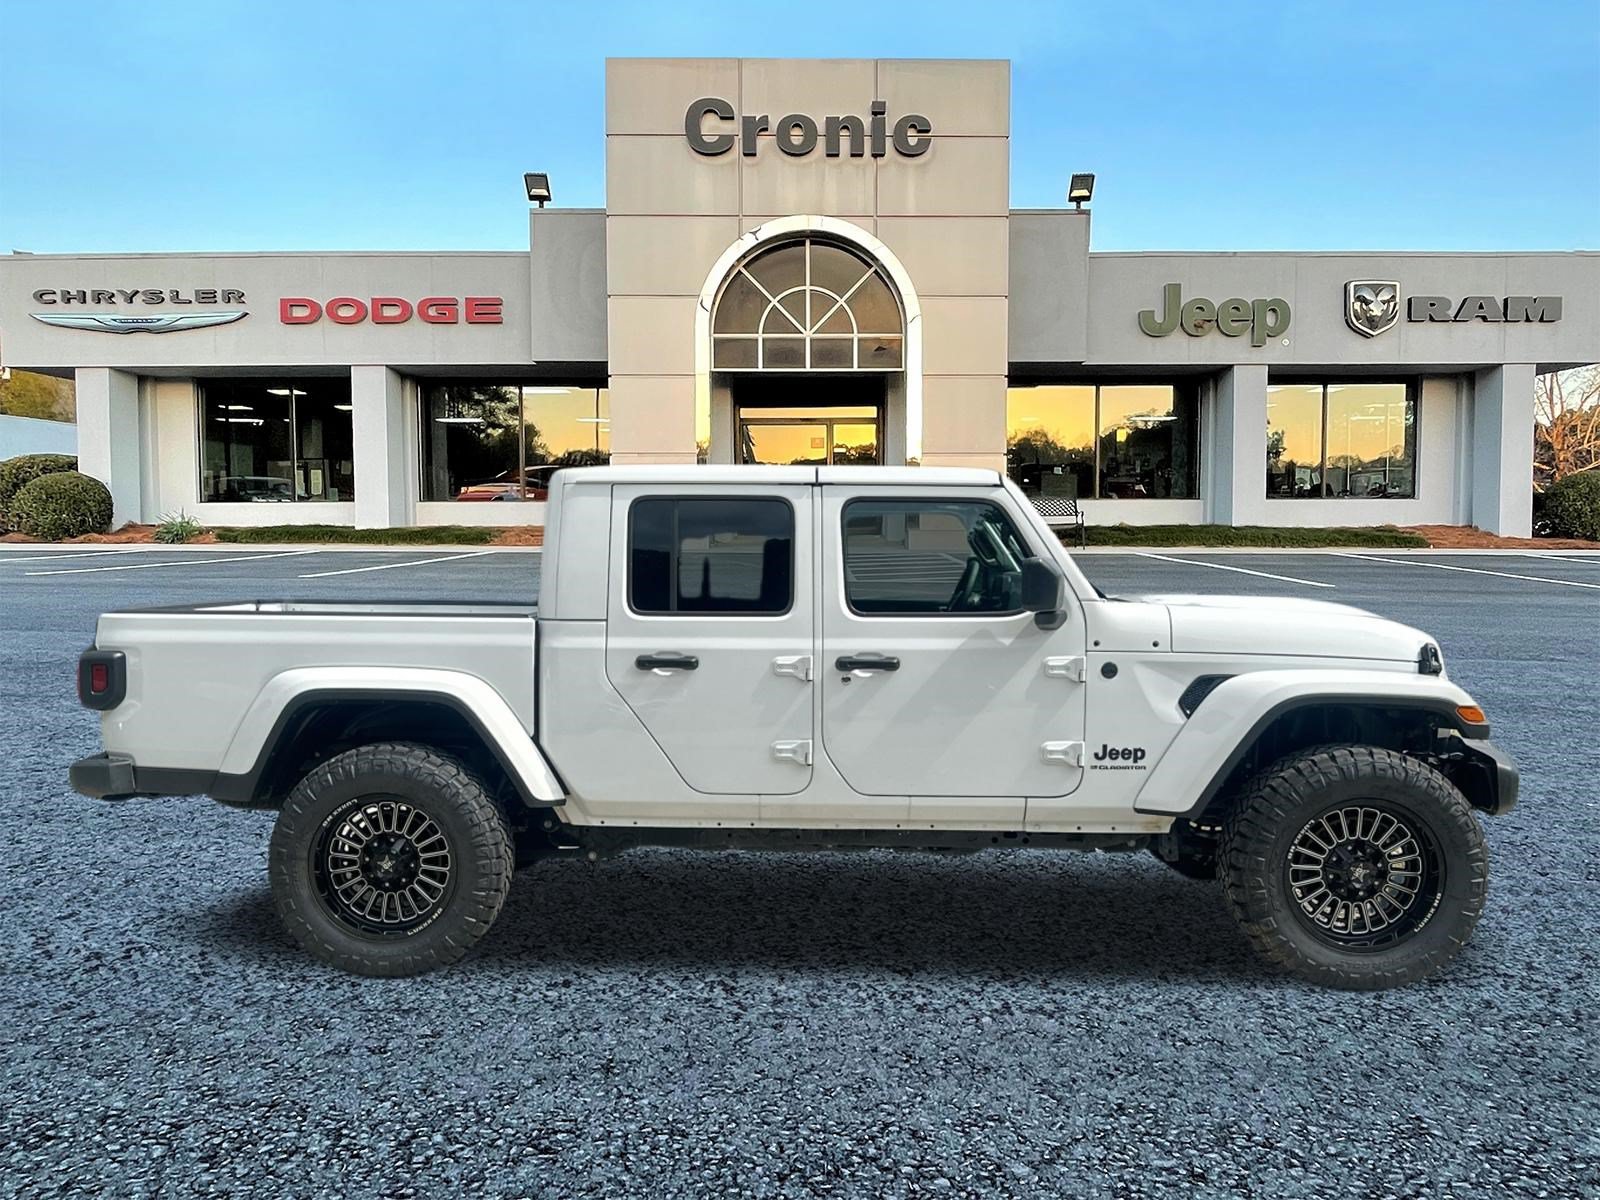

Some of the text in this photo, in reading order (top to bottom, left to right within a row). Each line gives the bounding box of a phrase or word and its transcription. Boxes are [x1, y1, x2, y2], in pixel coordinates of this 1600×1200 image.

[685, 97, 932, 157] Cronic
[32, 288, 247, 305] CHRYSLER
[1407, 295, 1563, 323] RAM
[279, 297, 503, 325] DODGE
[1138, 283, 1292, 347] Jeep
[1093, 743, 1146, 764] Jeep
